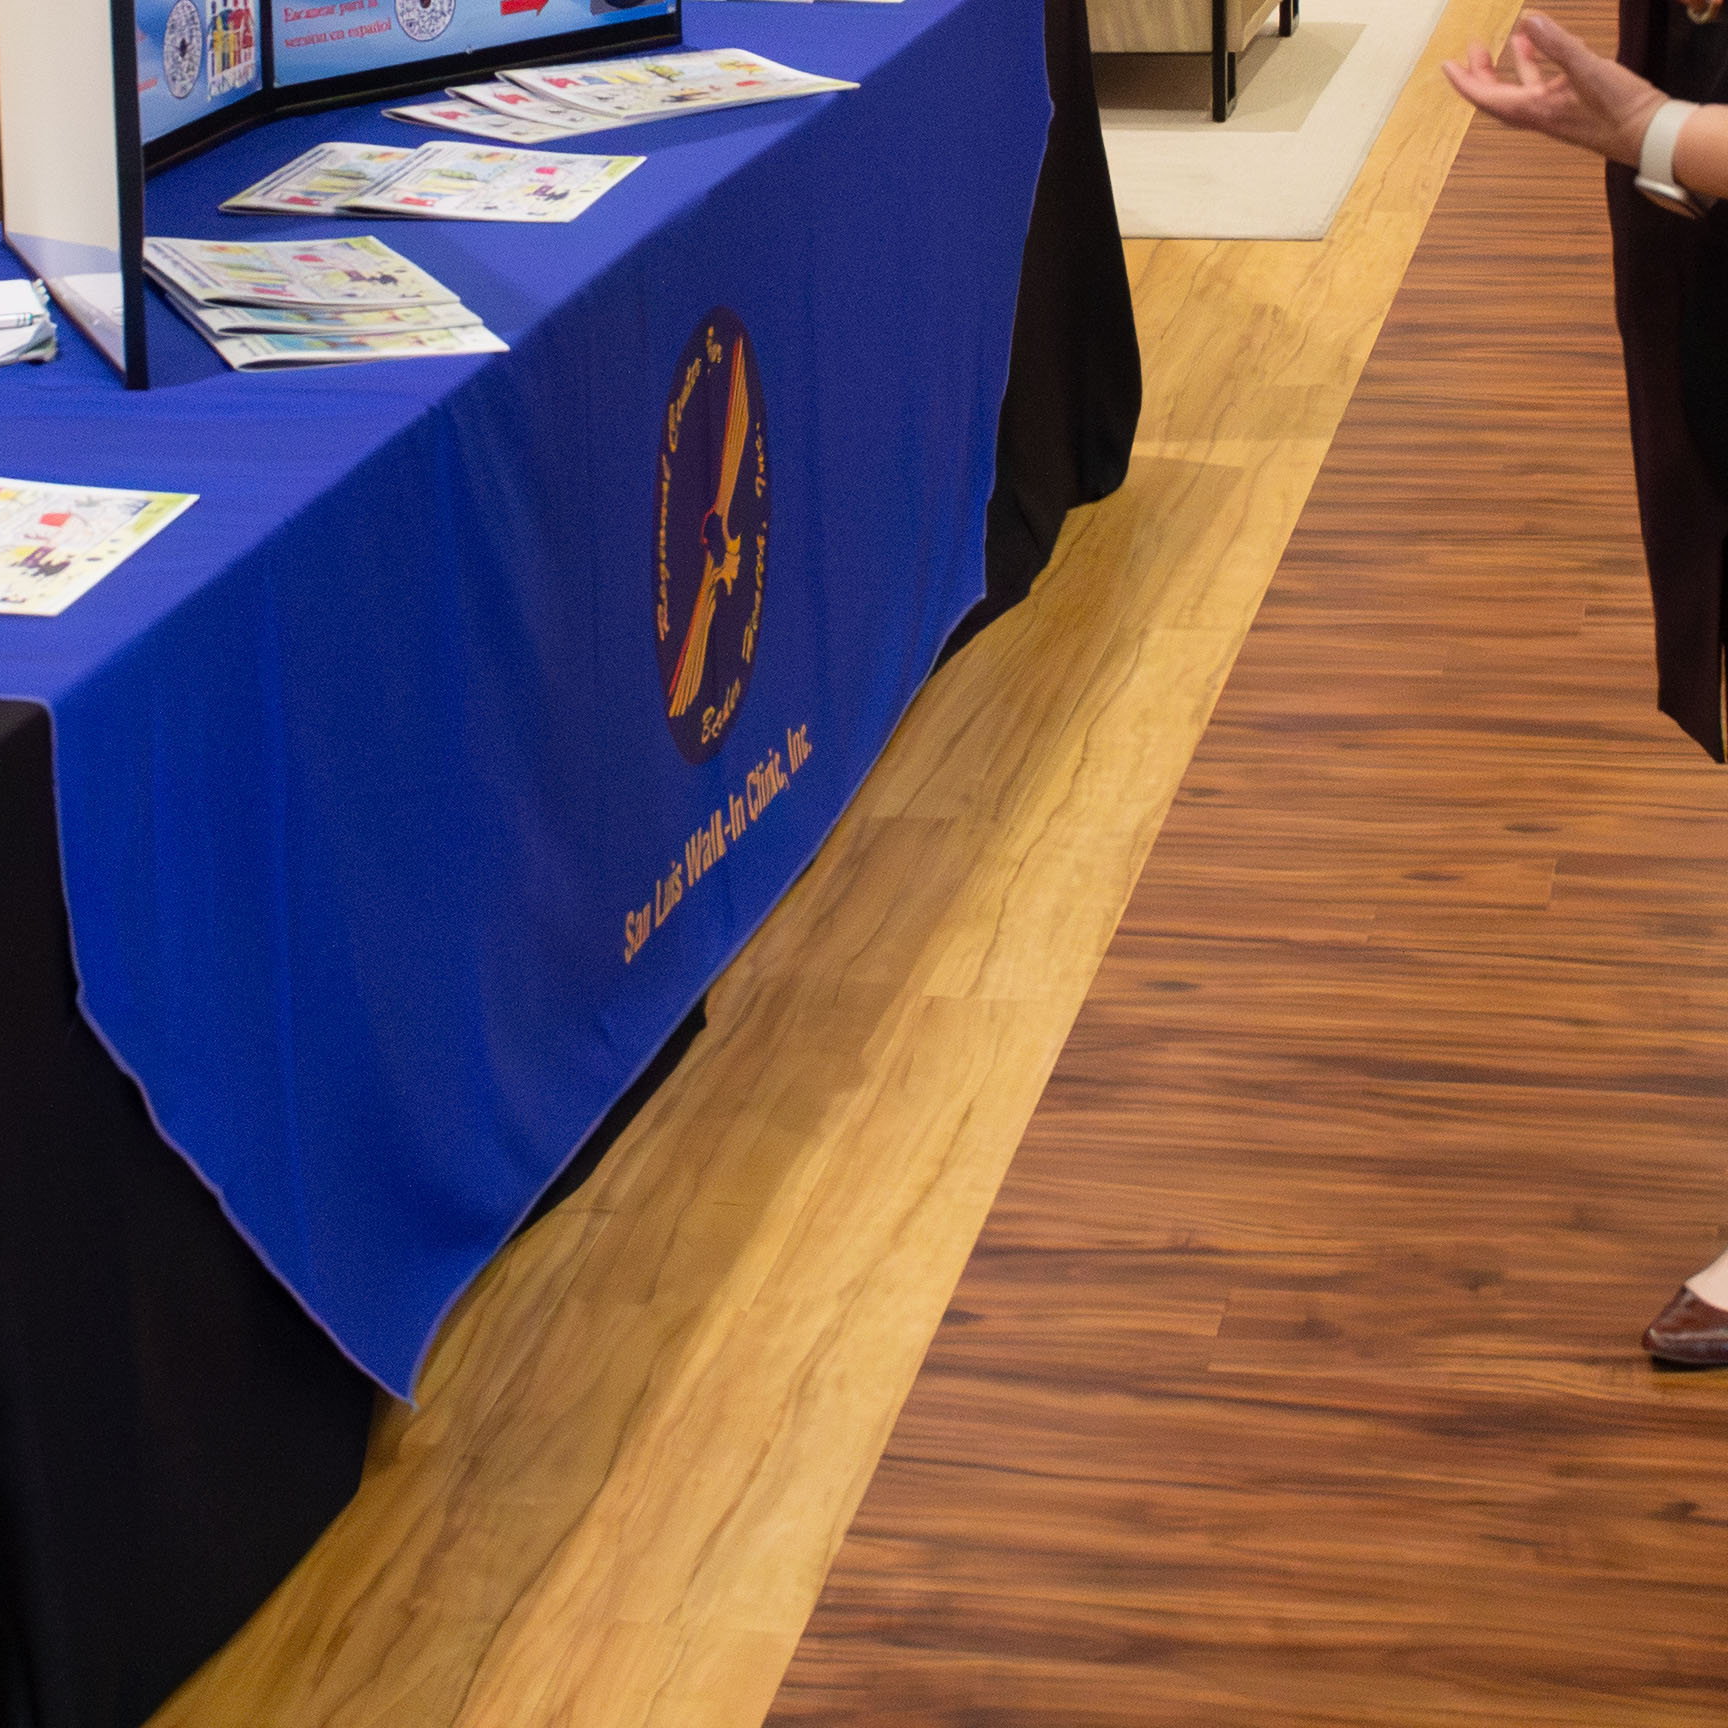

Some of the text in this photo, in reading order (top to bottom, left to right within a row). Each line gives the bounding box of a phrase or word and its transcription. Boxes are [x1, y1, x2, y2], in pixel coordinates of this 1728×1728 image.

[624, 723, 812, 965] San Luis Walk-In Clinic, Inc.
